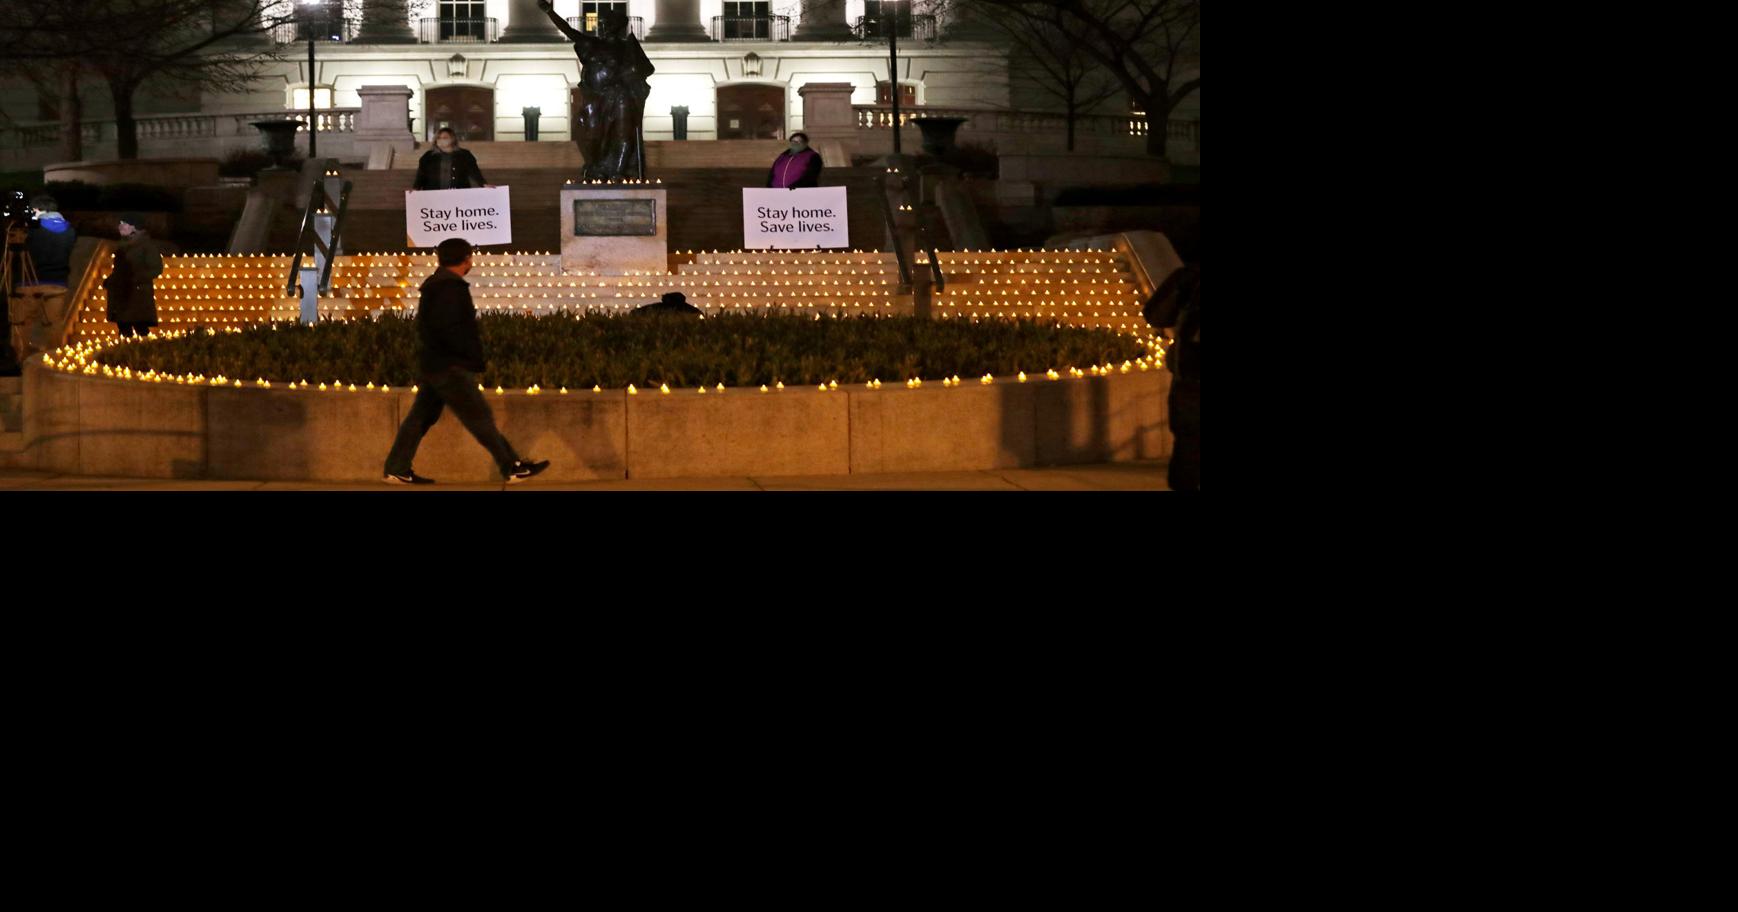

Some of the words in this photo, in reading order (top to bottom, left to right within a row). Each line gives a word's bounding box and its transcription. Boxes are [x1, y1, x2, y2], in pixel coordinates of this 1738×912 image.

[420, 207, 451, 221] Stay
[455, 205, 500, 218] home.
[757, 206, 788, 221] Stay
[792, 206, 836, 218] home.
[423, 220, 457, 232] Save
[461, 219, 497, 231] lives.
[760, 221, 794, 233] Save
[798, 220, 834, 232] lives.
